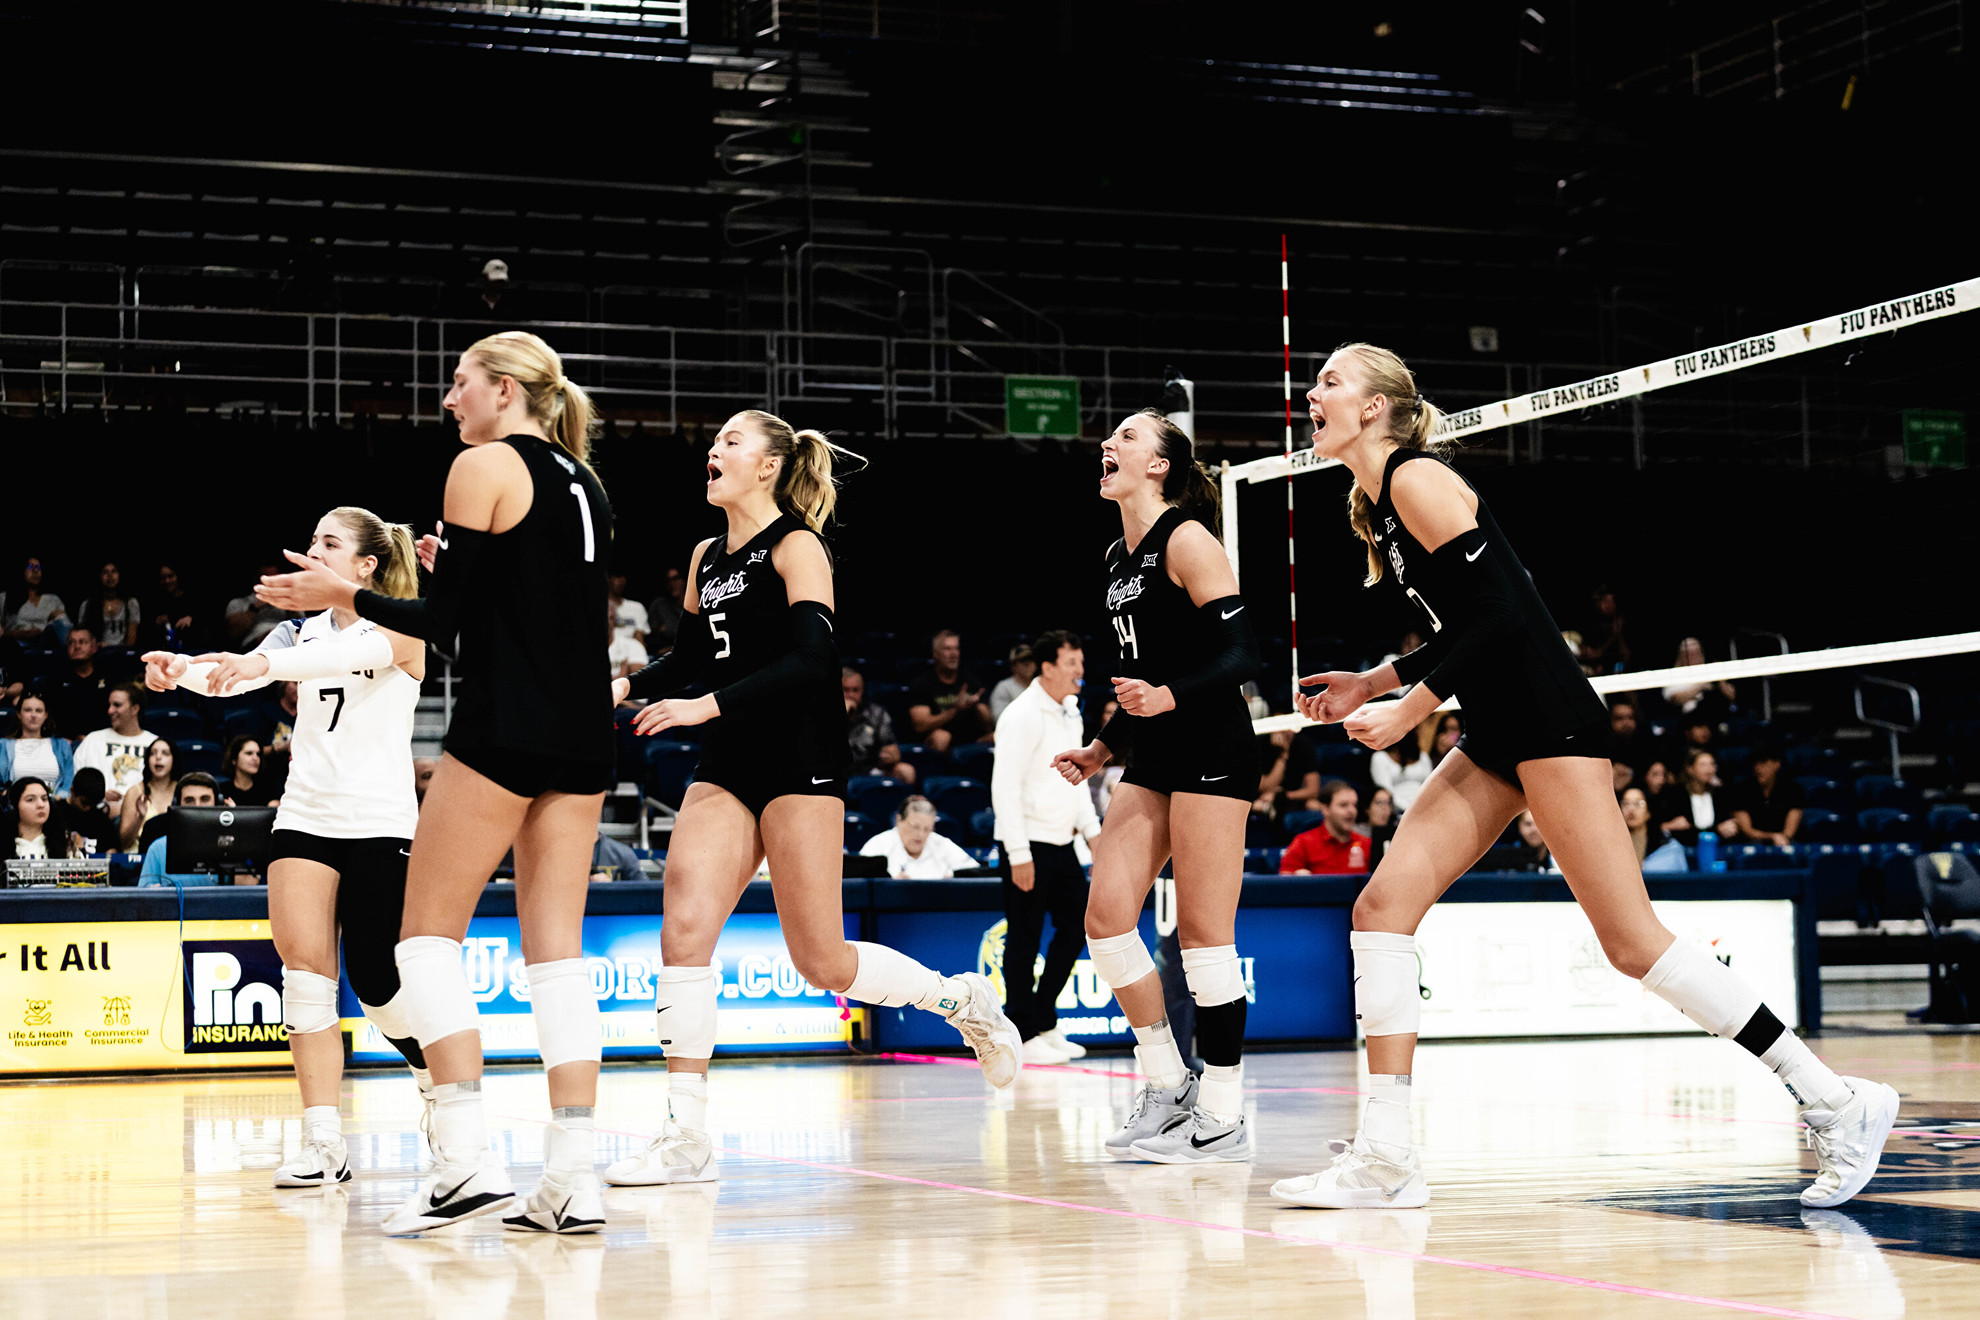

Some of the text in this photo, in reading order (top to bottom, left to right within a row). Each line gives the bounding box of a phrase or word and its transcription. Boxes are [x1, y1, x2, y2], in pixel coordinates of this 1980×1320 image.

[1840, 288, 1956, 334] FIU PANTHERS
[1675, 336, 1776, 377] FIU PANTHERS
[1531, 375, 1620, 412] FIU PANTHERS
[569, 482, 595, 563] 1
[699, 570, 748, 608] Knights
[1106, 574, 1145, 610] Knights
[708, 612, 730, 659] 5
[1112, 614, 1138, 659] 14
[319, 687, 345, 732] 7
[106, 743, 148, 758] FIU
[21, 941, 111, 971] It All
[8, 1030, 73, 1039] Life & Health
[14, 1038, 67, 1047] Insurance
[84, 1028, 149, 1038] Commercial
[90, 1037, 143, 1045] Insurance
[192, 1024, 290, 1044] INSURANC
